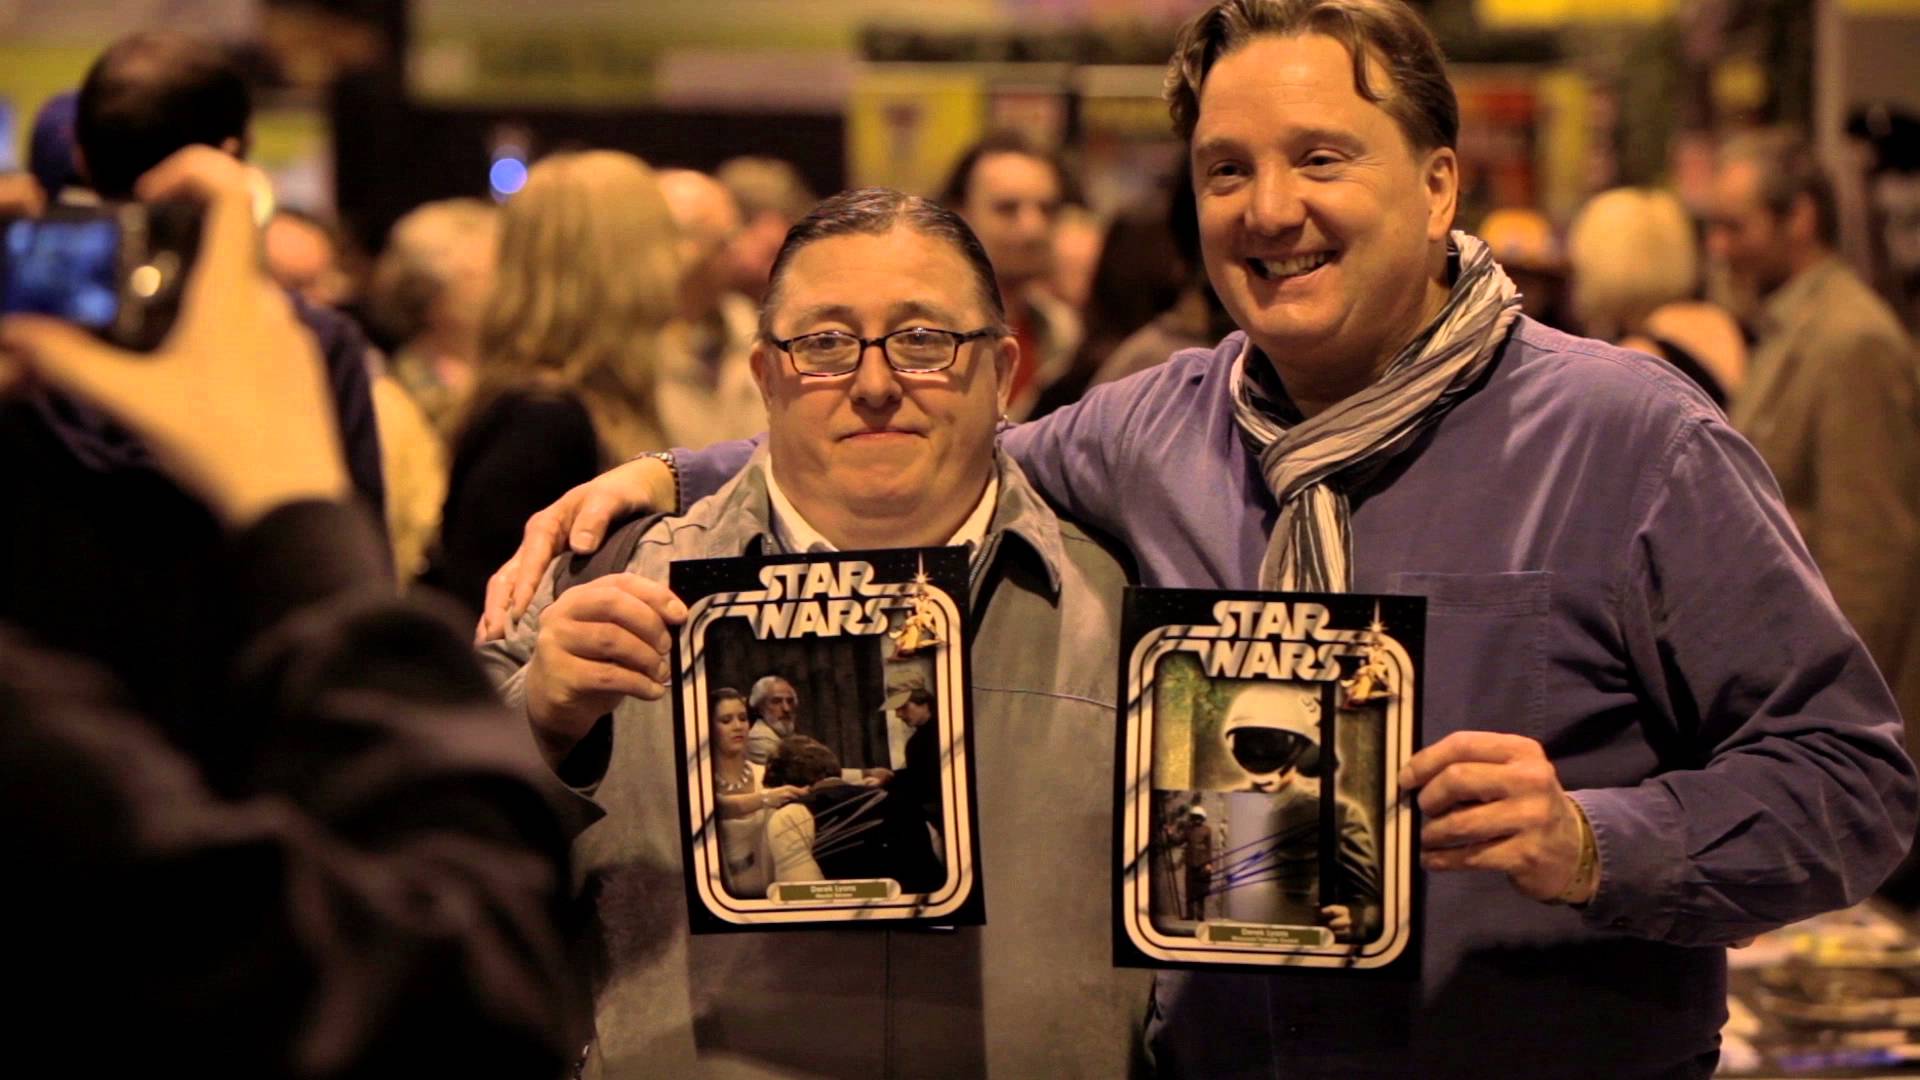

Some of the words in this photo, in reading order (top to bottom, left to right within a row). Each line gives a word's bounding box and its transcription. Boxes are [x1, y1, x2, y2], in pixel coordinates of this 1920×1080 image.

[759, 561, 876, 600] STAR
[747, 598, 889, 640] WARS
[1213, 600, 1331, 640] STAR
[1200, 639, 1341, 681] WARS
